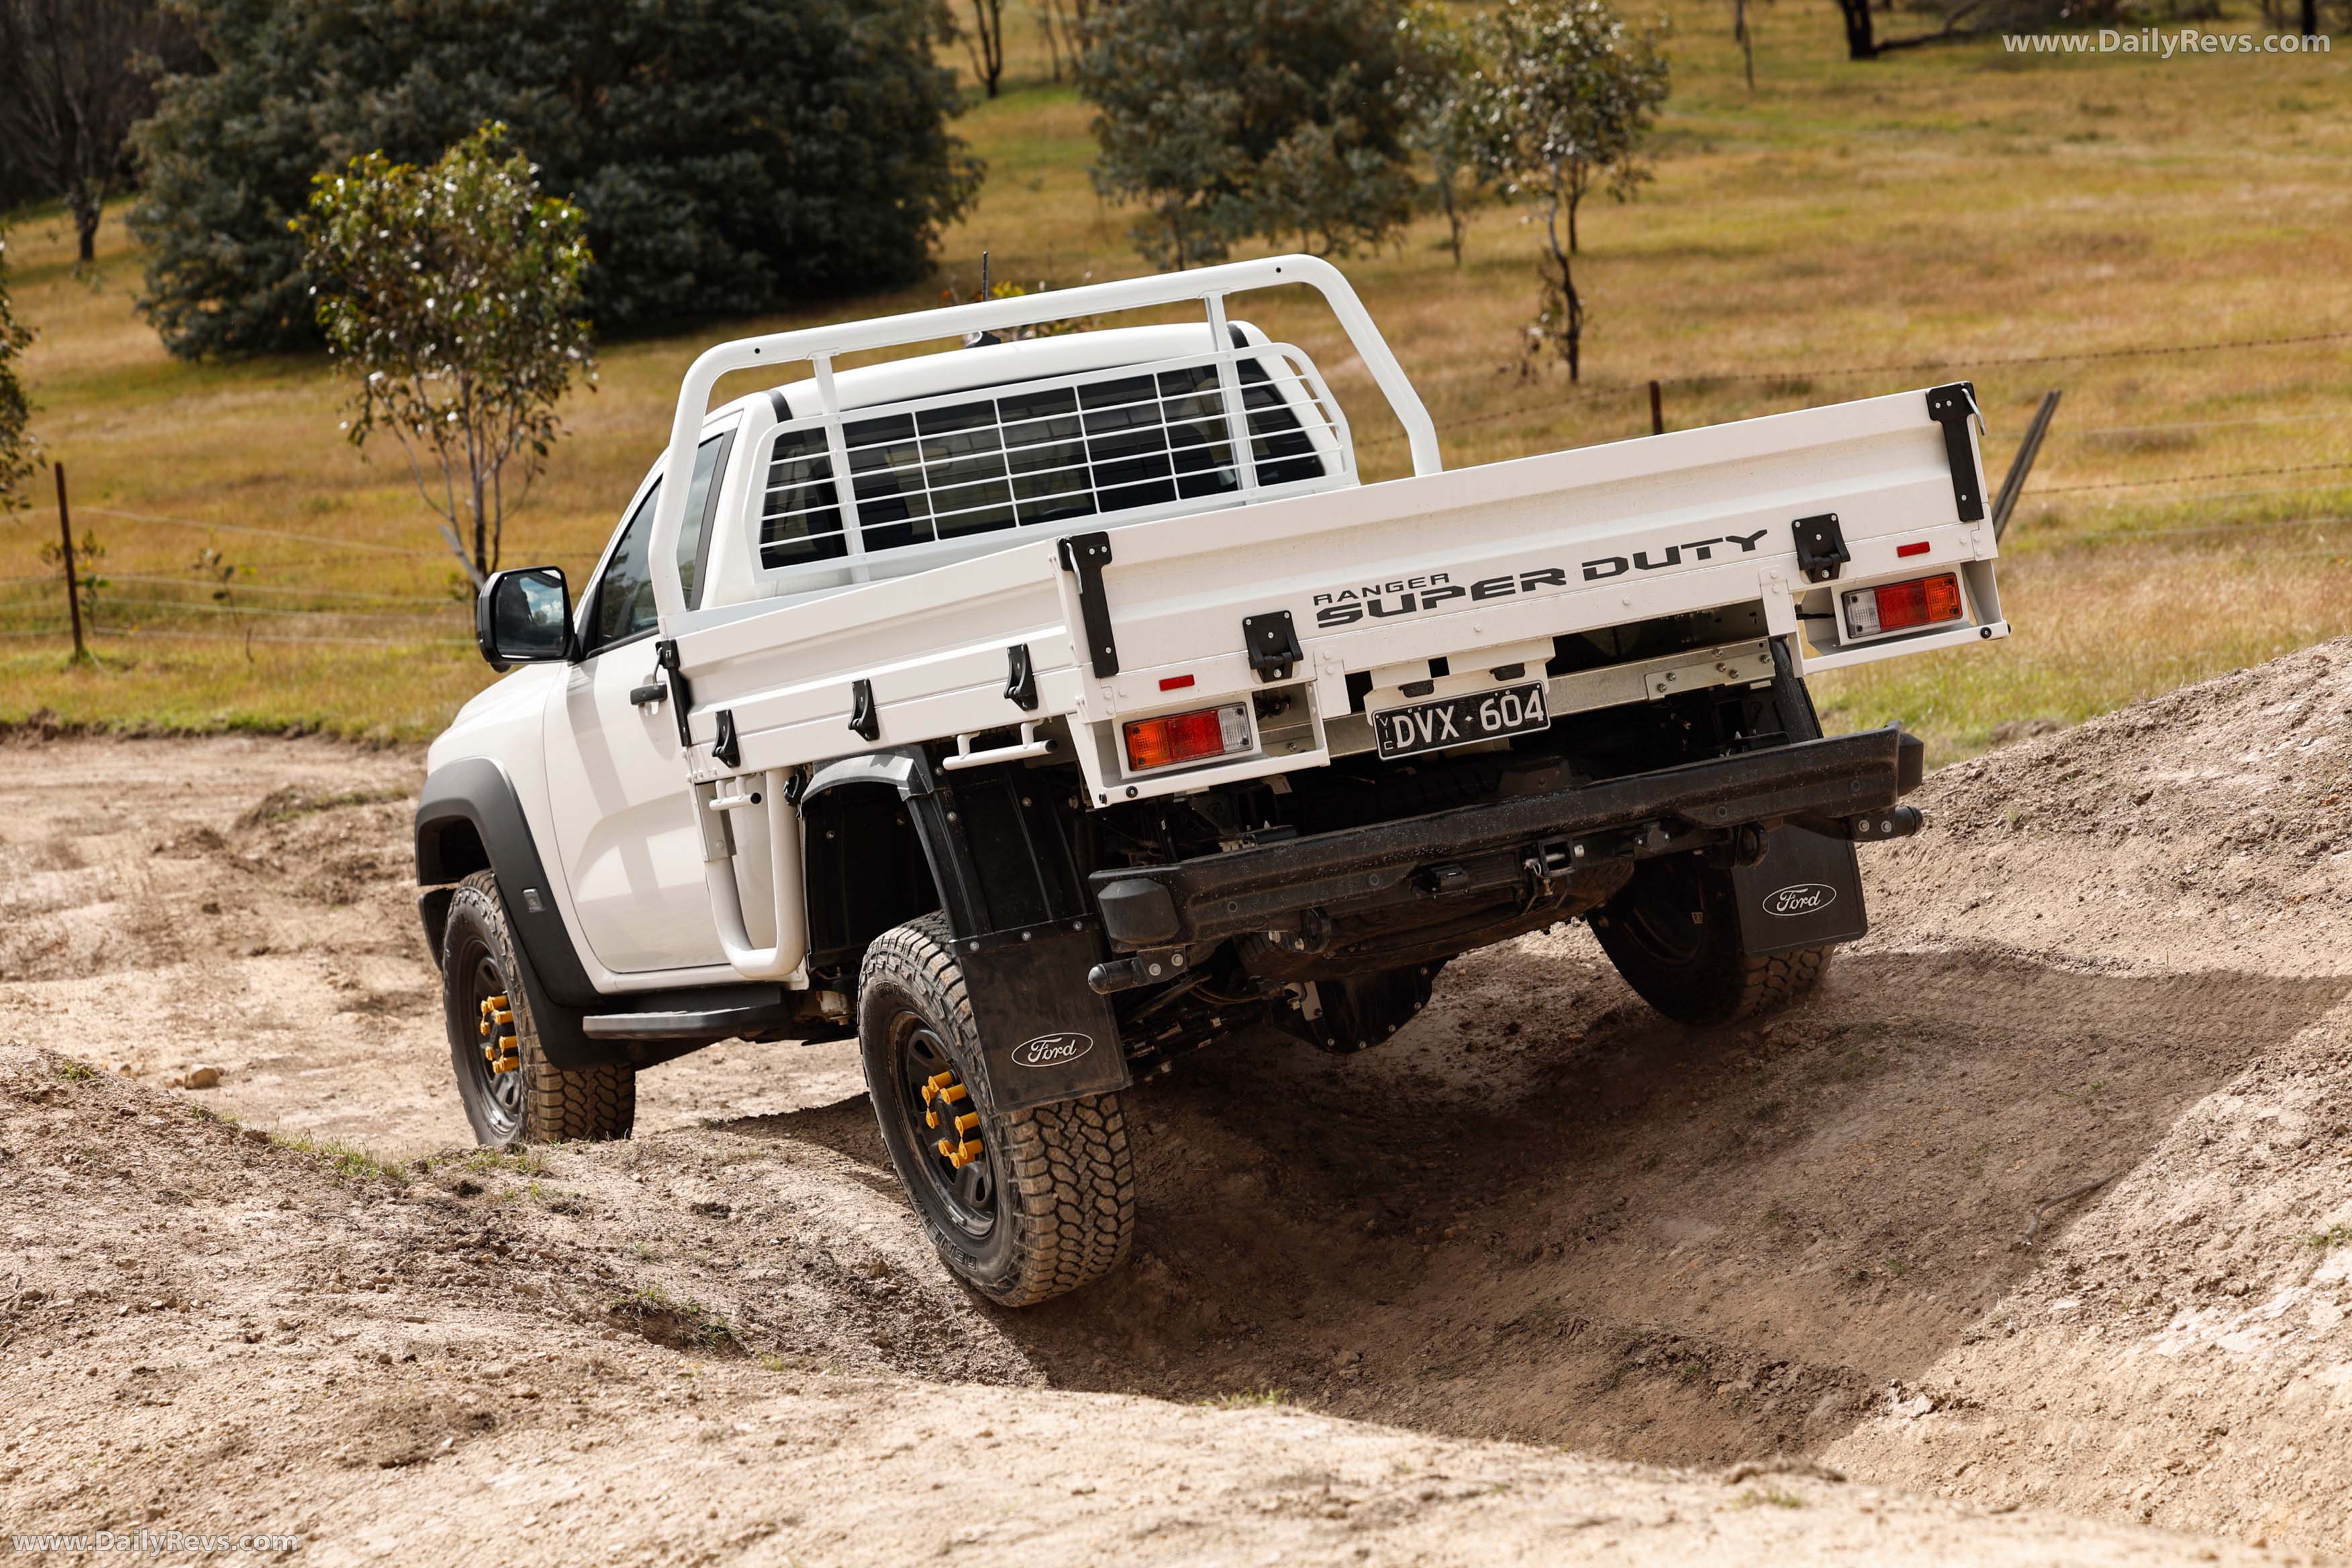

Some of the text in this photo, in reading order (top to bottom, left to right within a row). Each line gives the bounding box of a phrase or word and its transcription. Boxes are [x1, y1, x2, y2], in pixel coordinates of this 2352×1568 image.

[1313, 573, 1450, 606] RANGER
[1316, 530, 1768, 629] SUPER DUTY
[1379, 717, 1394, 750] VIC
[1392, 689, 1544, 748] DVX 604
[1776, 888, 1821, 912] Ford
[1028, 1037, 1077, 1063] Ford
